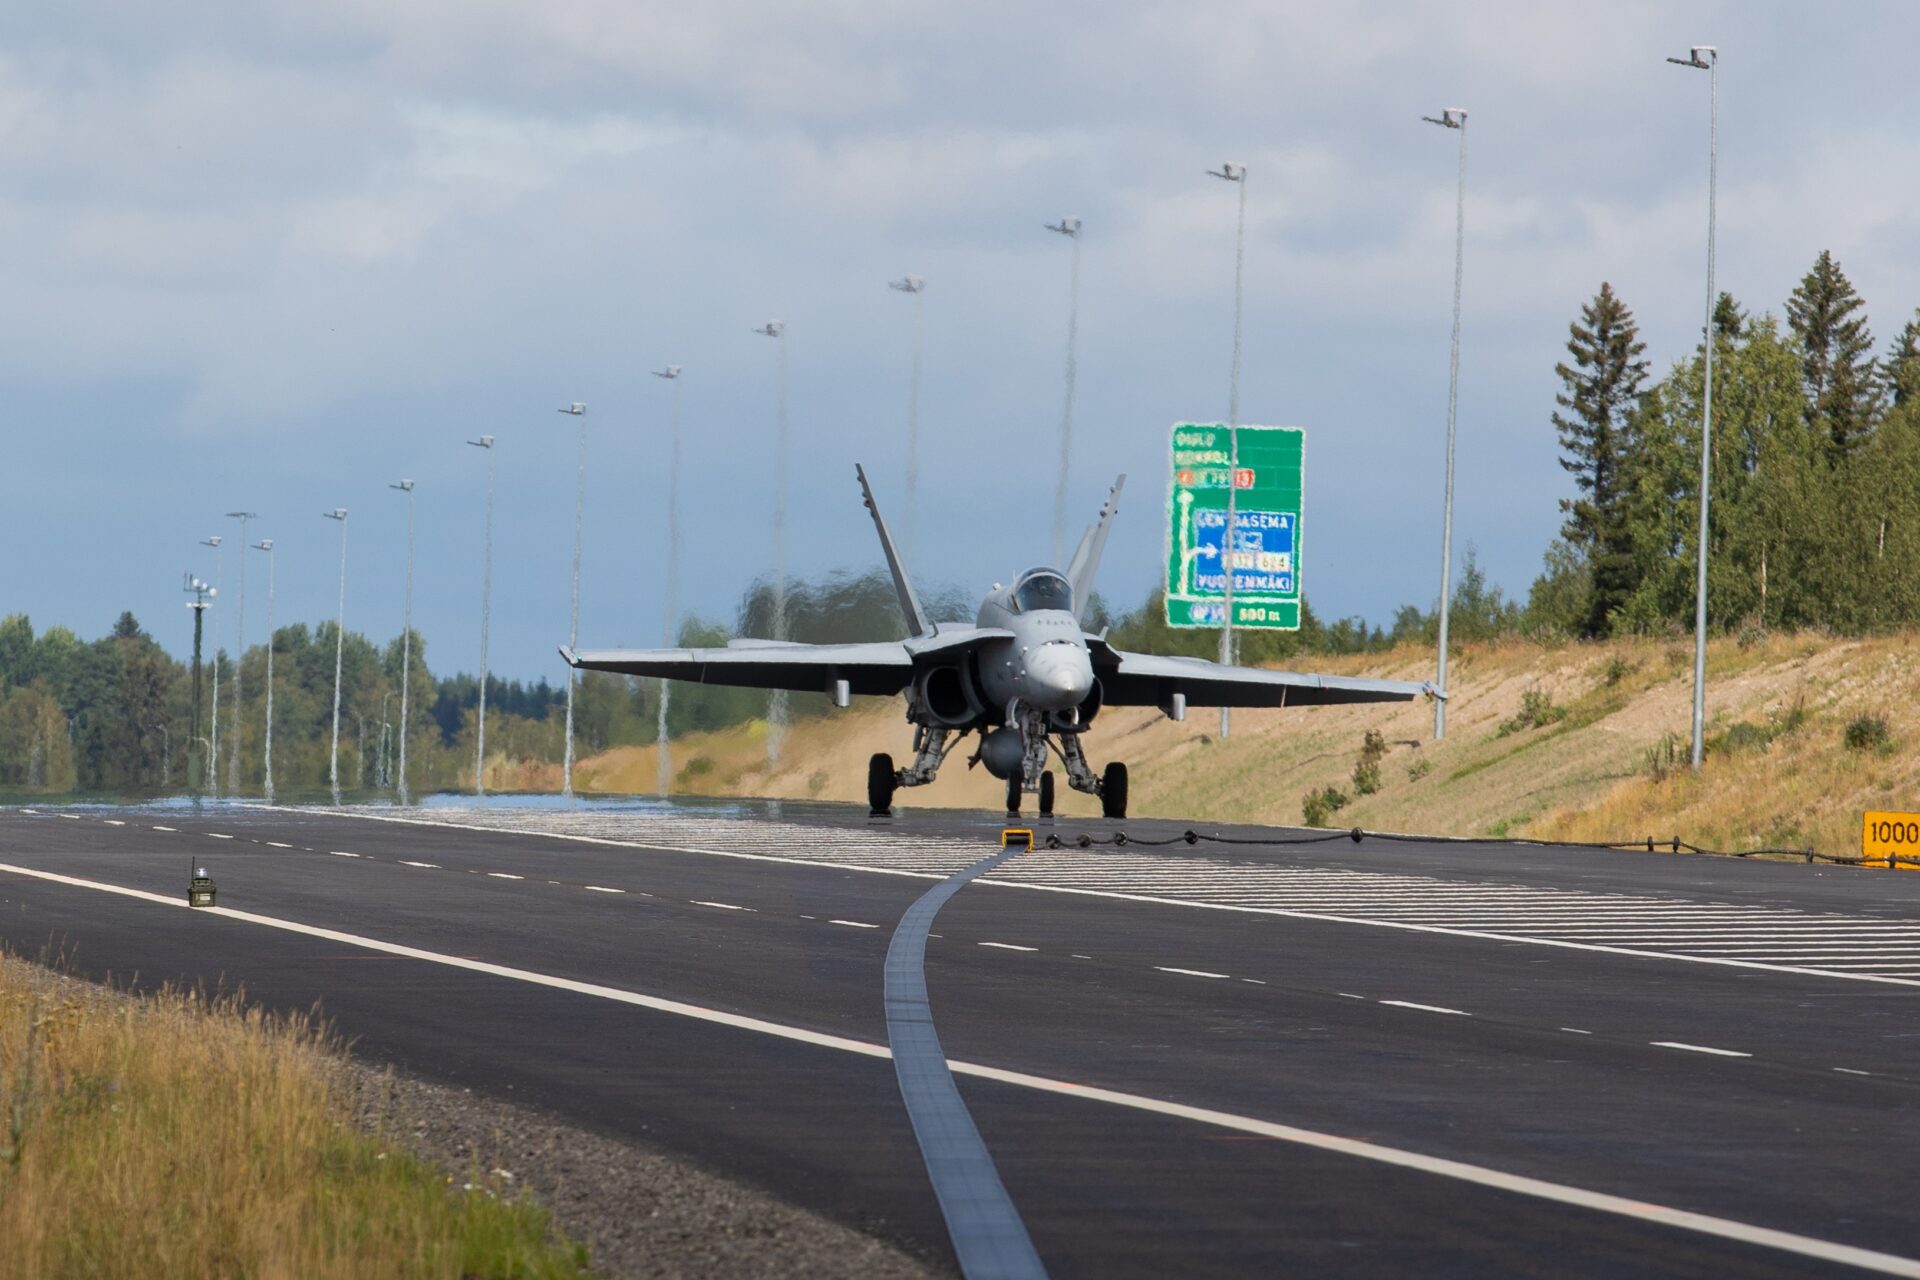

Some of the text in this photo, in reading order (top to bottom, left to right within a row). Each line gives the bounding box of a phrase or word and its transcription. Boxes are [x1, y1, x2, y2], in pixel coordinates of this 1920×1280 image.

[1198, 573, 1290, 591] VUOENMÄKI
[1269, 611, 1280, 622] m
[1871, 821, 1919, 843] 1000
